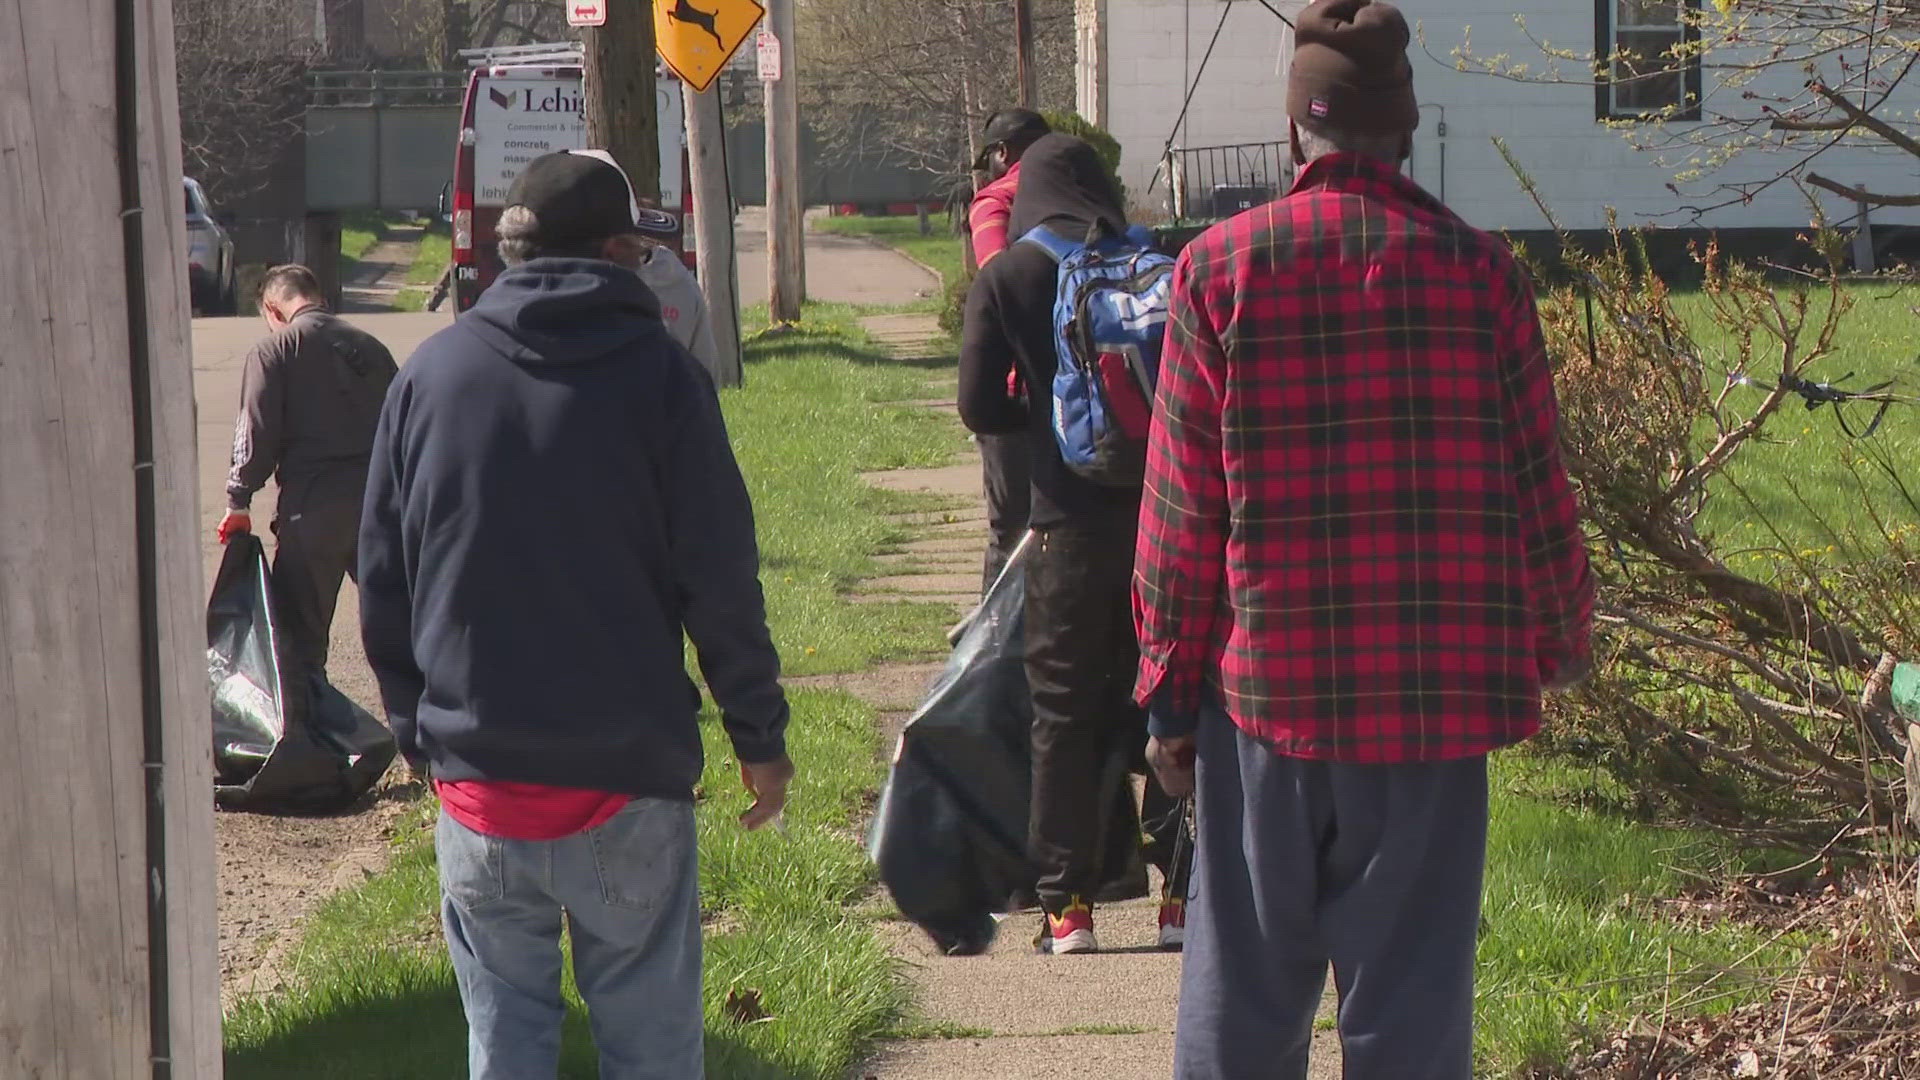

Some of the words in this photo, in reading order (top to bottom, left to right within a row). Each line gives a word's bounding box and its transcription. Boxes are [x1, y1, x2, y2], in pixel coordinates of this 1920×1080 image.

[507, 122, 557, 132] Commercial
[560, 123, 566, 132] &
[504, 140, 550, 150] concrete
